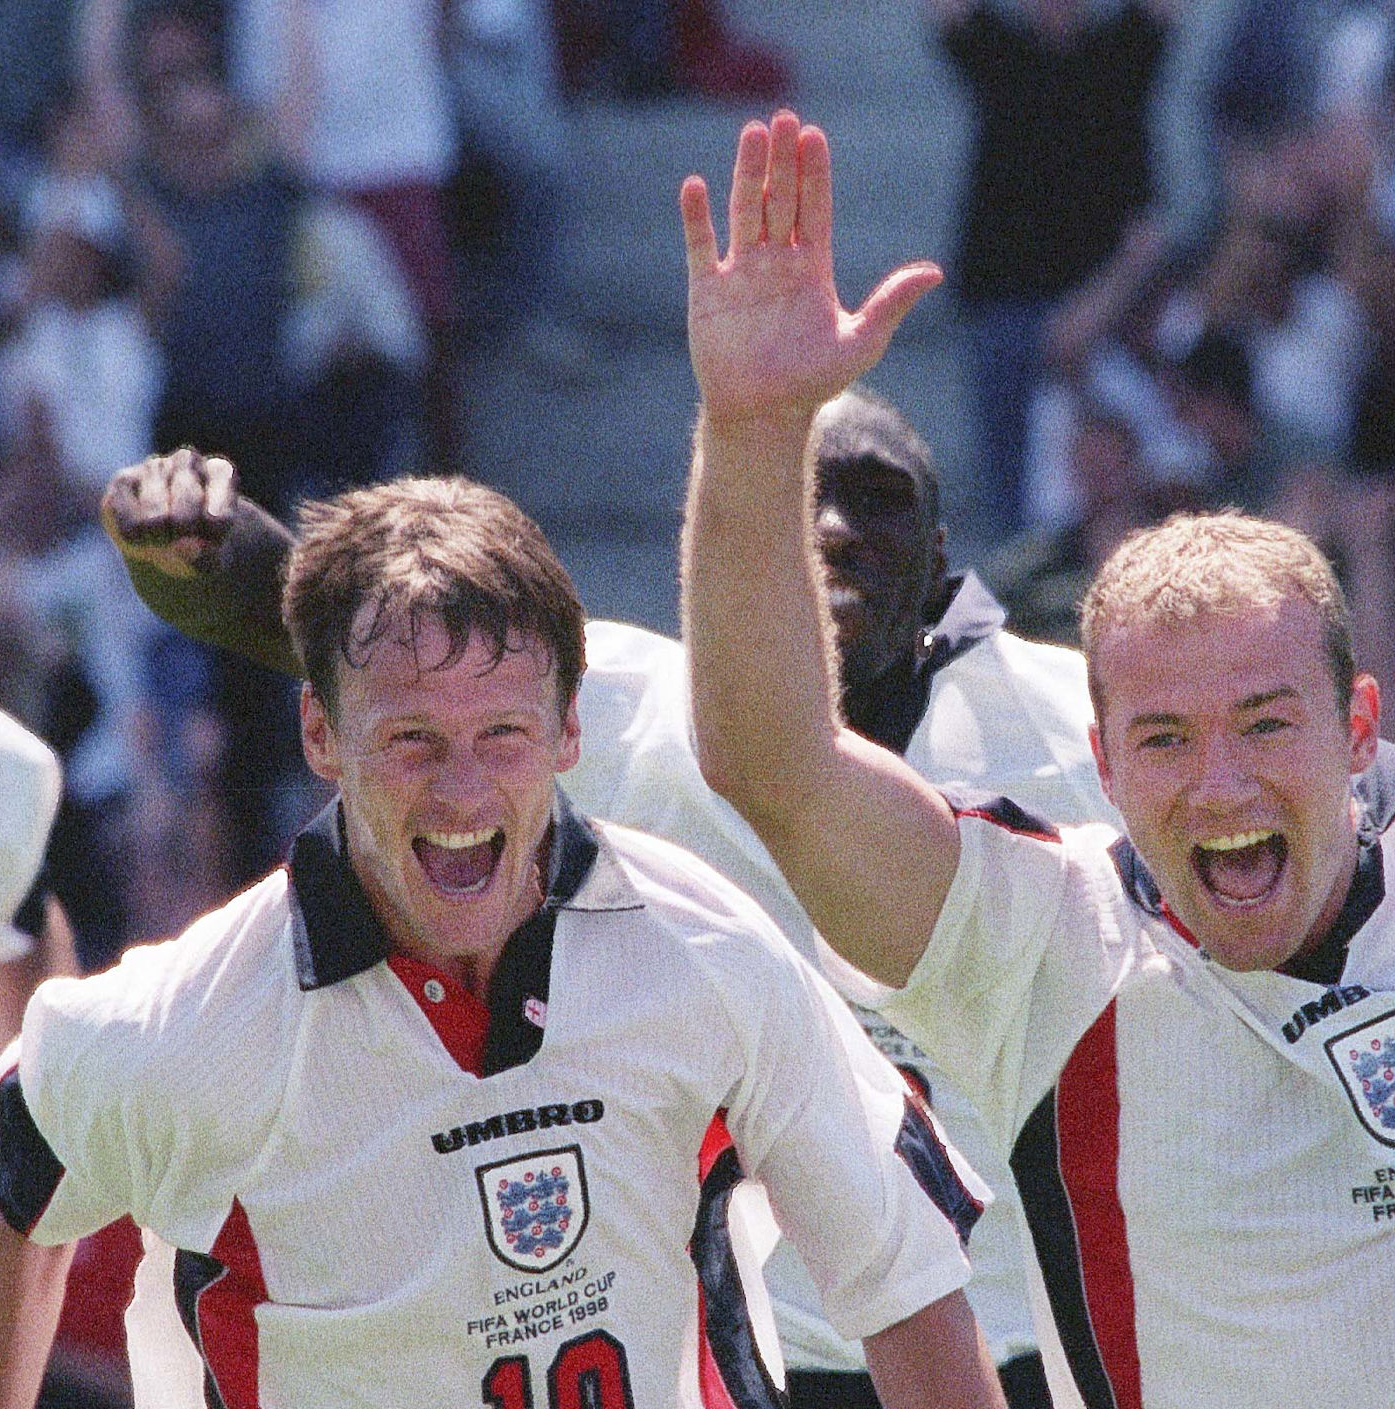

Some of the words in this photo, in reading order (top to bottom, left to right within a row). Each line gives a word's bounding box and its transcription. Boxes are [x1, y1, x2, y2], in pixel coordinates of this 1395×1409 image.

[1281, 984, 1371, 1044] UMB
[431, 1099, 604, 1154] UMBRO
[1351, 1184, 1395, 1204] FIFA
[467, 1314, 508, 1335] FIFA
[514, 1294, 579, 1325] WORLD
[583, 1272, 617, 1300] CUP
[494, 1266, 588, 1305] ENGLAND
[486, 1318, 564, 1348] FRANCE
[569, 1297, 609, 1326] 1998
